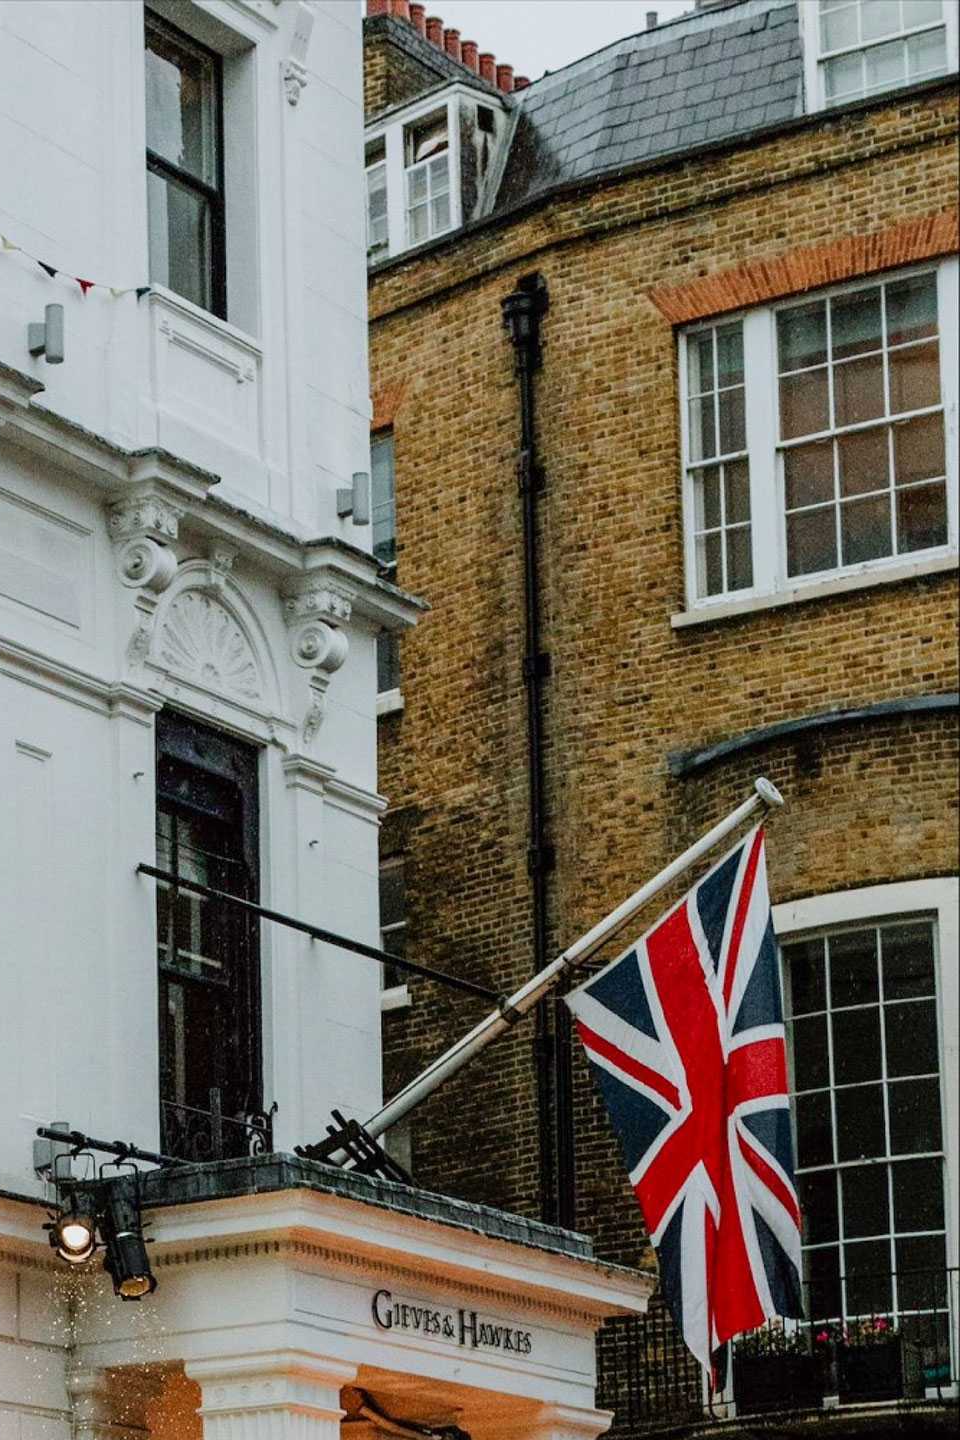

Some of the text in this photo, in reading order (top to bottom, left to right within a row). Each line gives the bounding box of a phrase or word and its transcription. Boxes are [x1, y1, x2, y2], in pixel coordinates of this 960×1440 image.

[371, 1289, 533, 1354] GIEVES & HAWKES
